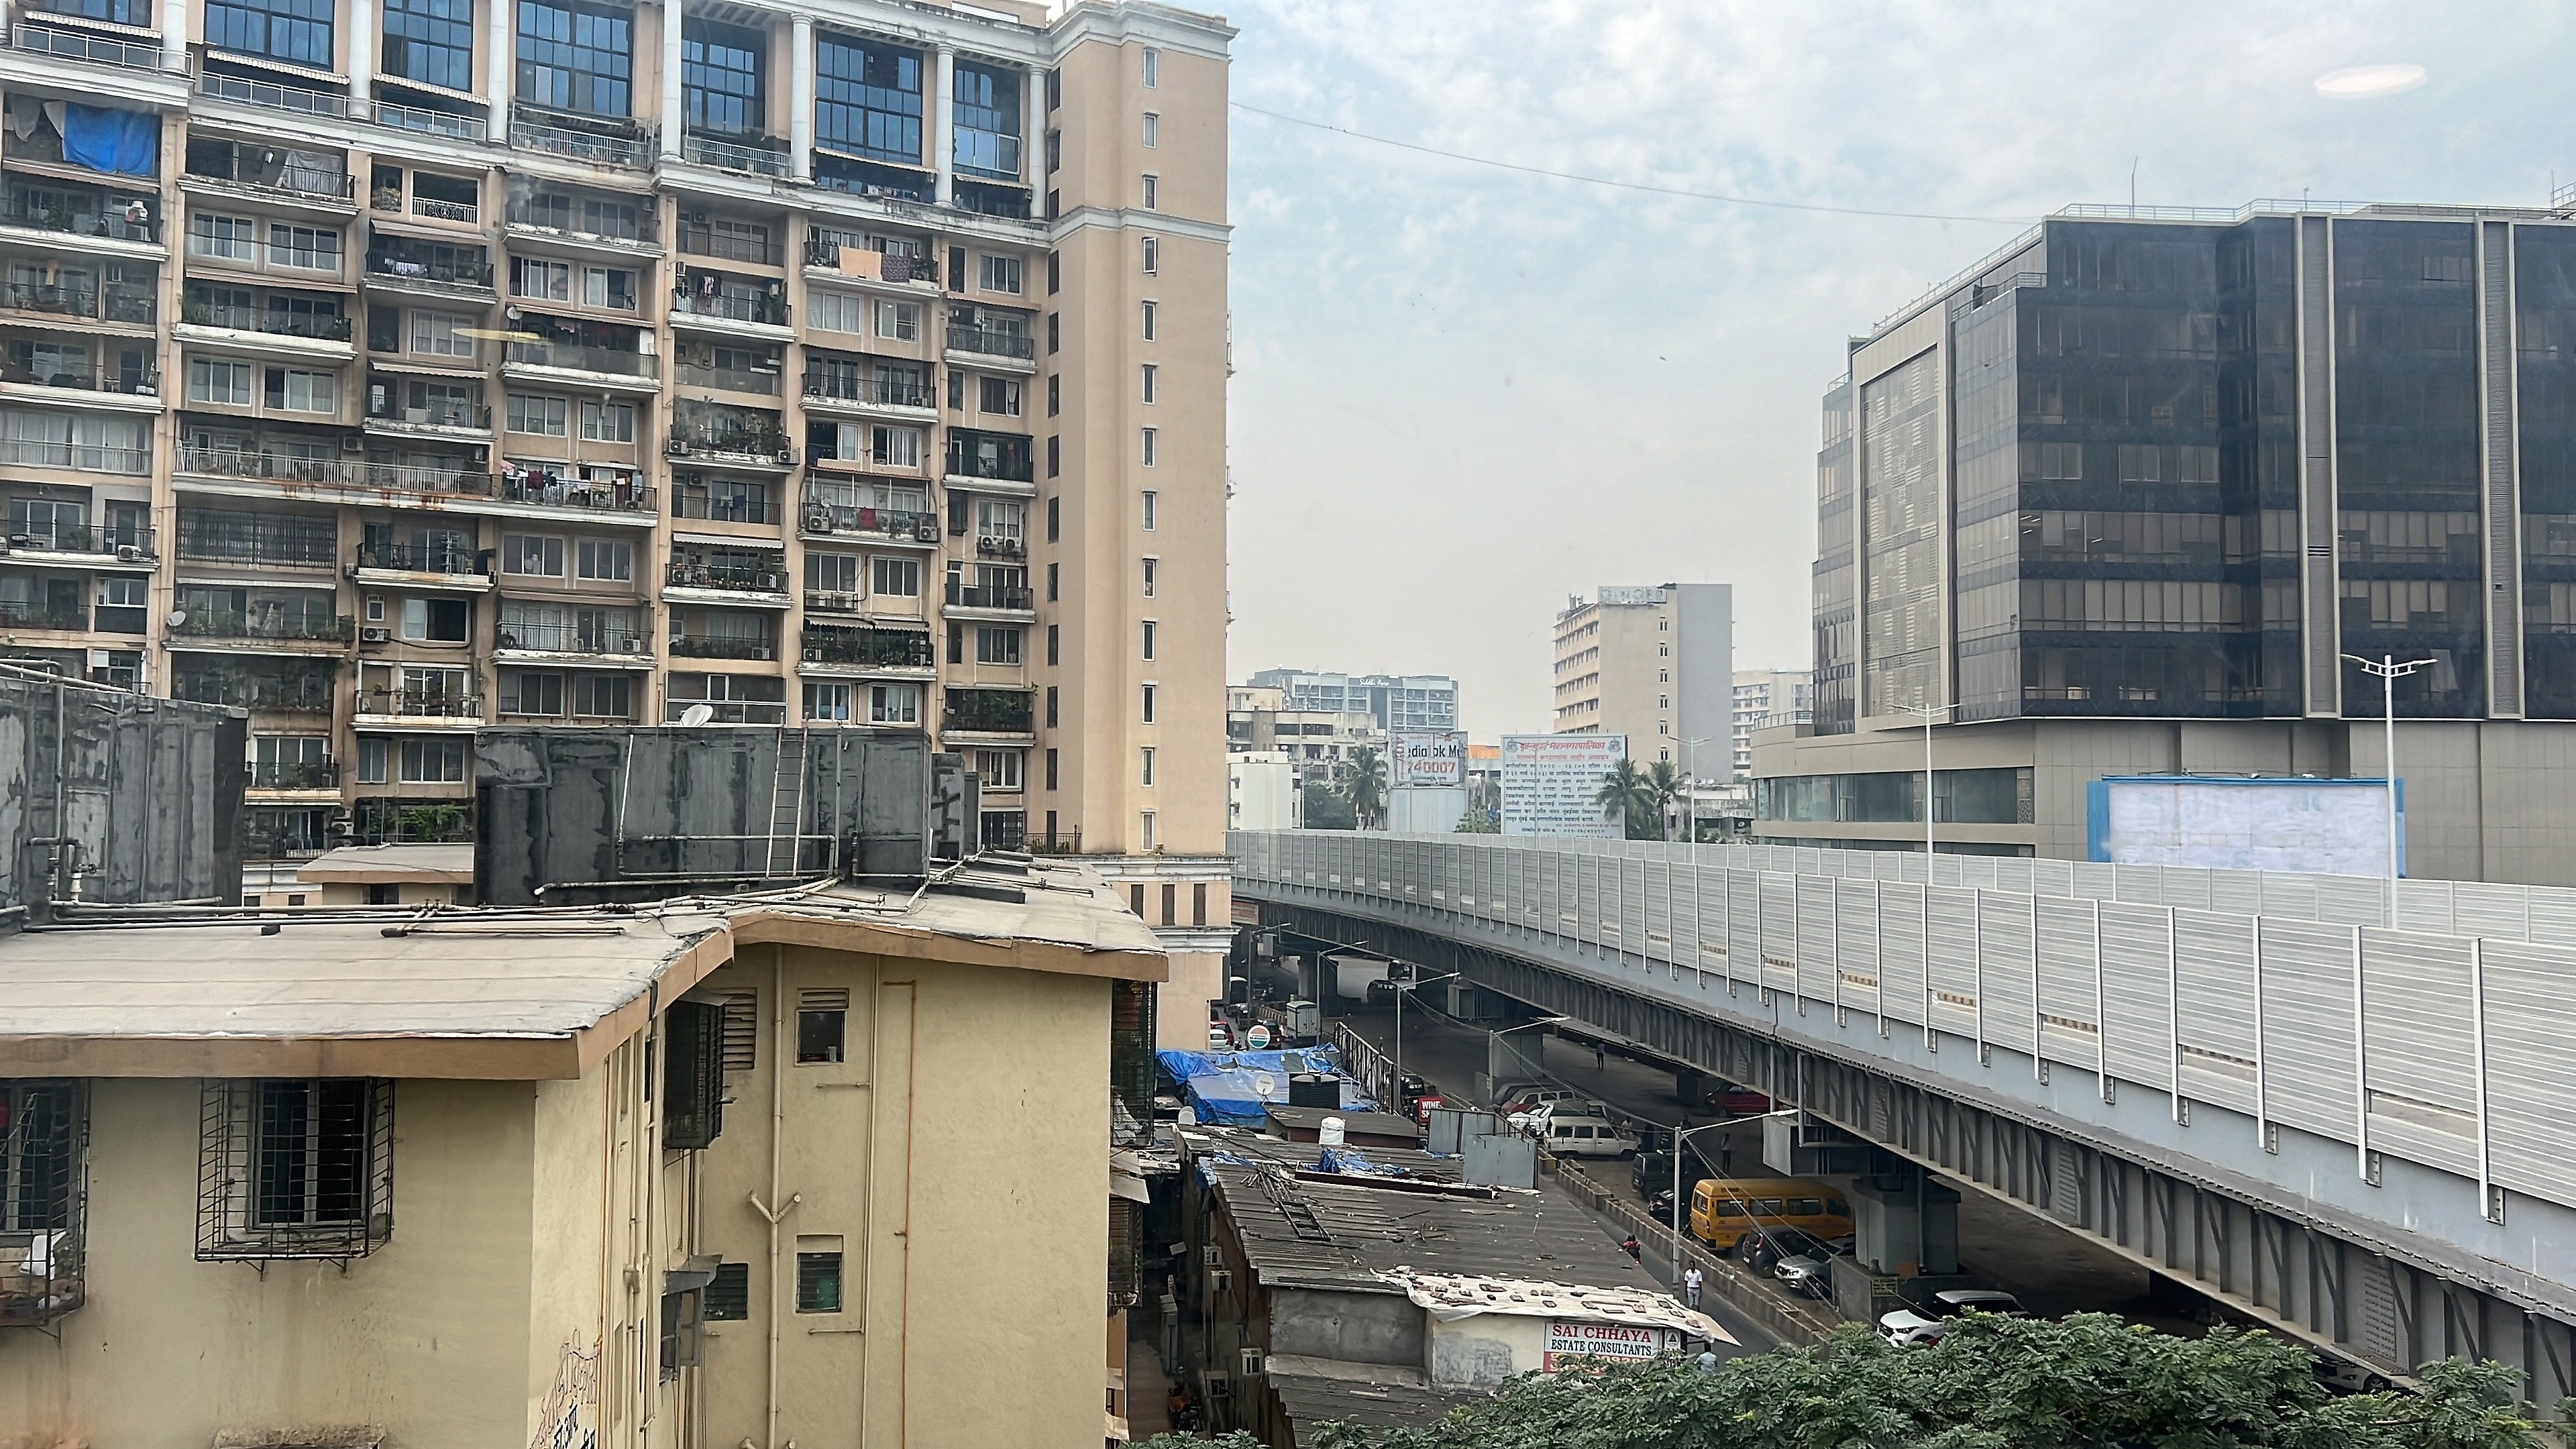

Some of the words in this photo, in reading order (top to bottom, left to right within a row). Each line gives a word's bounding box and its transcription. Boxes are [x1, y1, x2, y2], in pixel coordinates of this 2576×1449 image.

[1552, 1324, 1578, 1338] SAI
[1584, 1326, 1652, 1343] CHHAYA
[1551, 1338, 1585, 1352] ESTATE
[1587, 1341, 1652, 1356] CONSULTANTS
